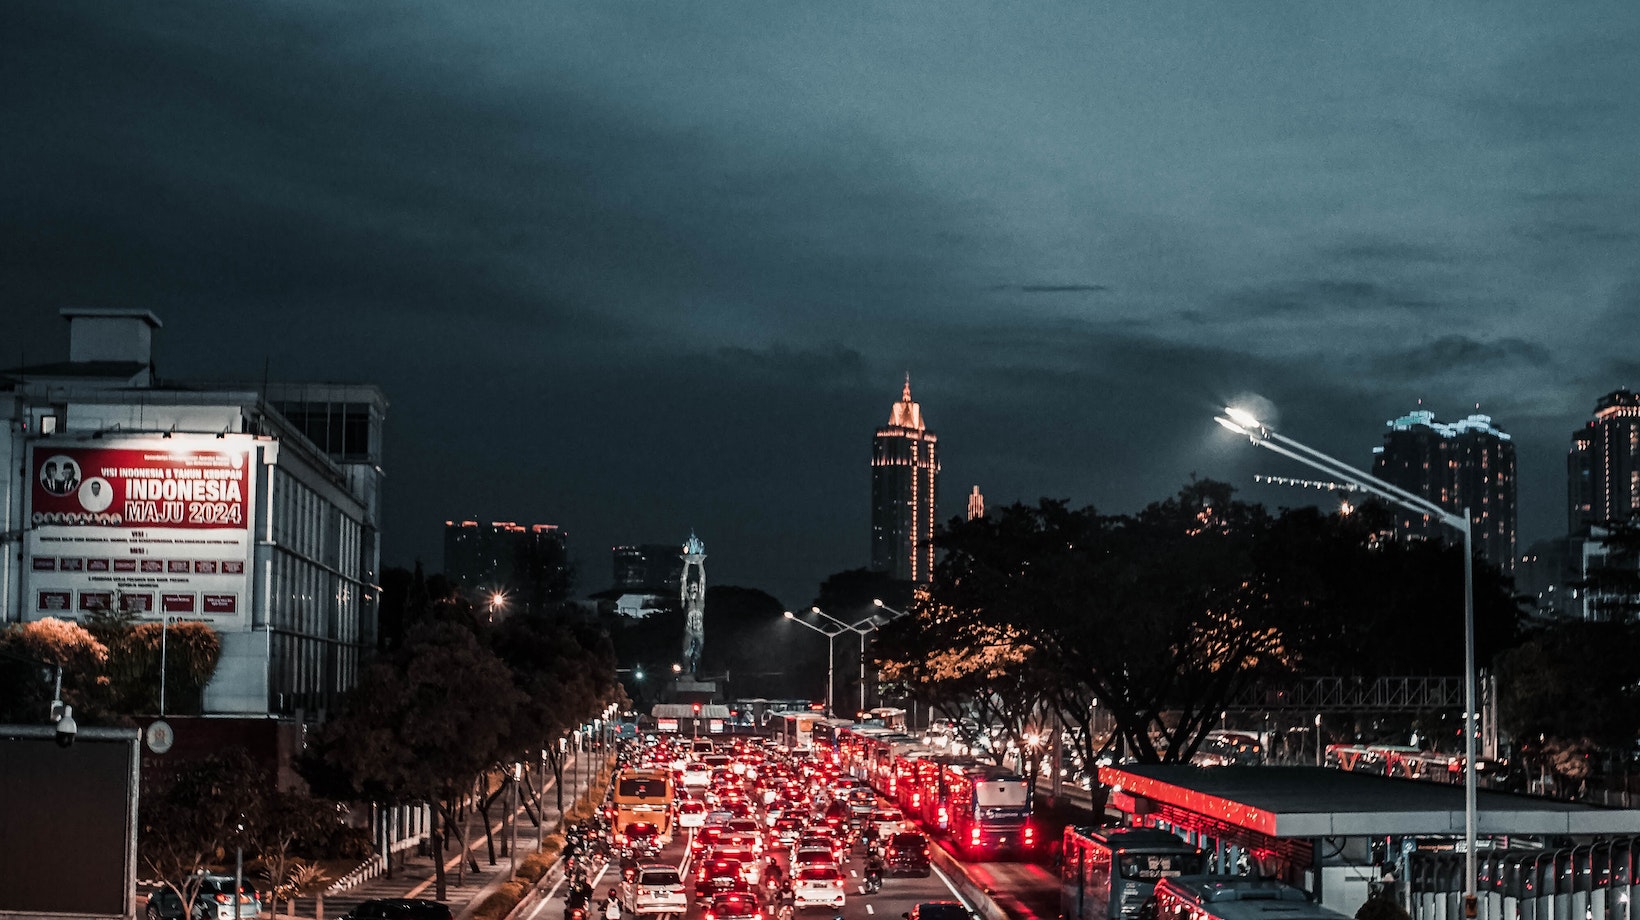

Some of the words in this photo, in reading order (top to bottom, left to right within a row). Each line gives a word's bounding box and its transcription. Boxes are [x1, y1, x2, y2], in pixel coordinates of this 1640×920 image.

[101, 467, 117, 478] VISI
[119, 467, 164, 479] INDONESIA
[125, 478, 242, 502] INDONESIA
[124, 500, 184, 523] MAJU
[188, 502, 242, 524] 2024
